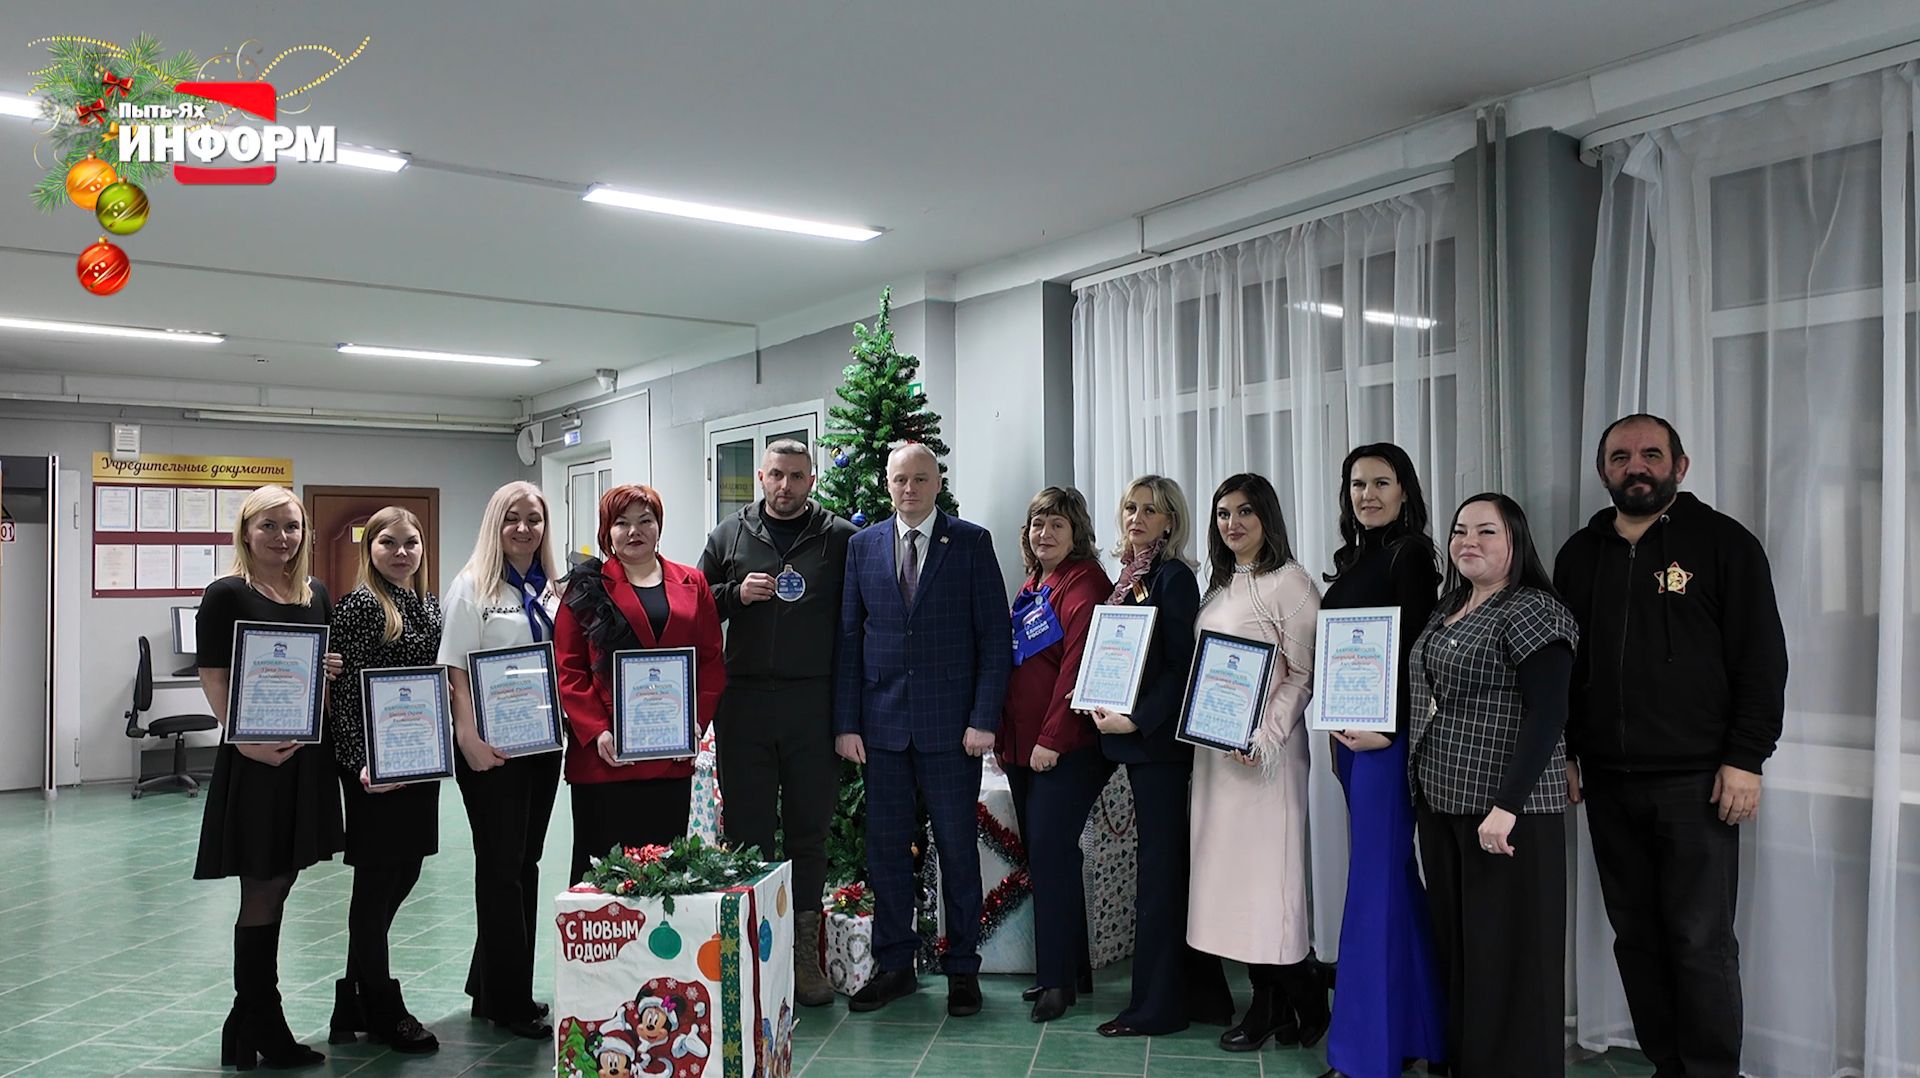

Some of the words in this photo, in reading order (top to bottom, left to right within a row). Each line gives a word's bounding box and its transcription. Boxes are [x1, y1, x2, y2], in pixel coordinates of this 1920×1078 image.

[102, 457, 208, 475] Учредительные
[211, 463, 286, 478] документы
[565, 920, 577, 940] С
[582, 920, 639, 941] НОВЫМ
[567, 942, 617, 962] ГОДОМ!
